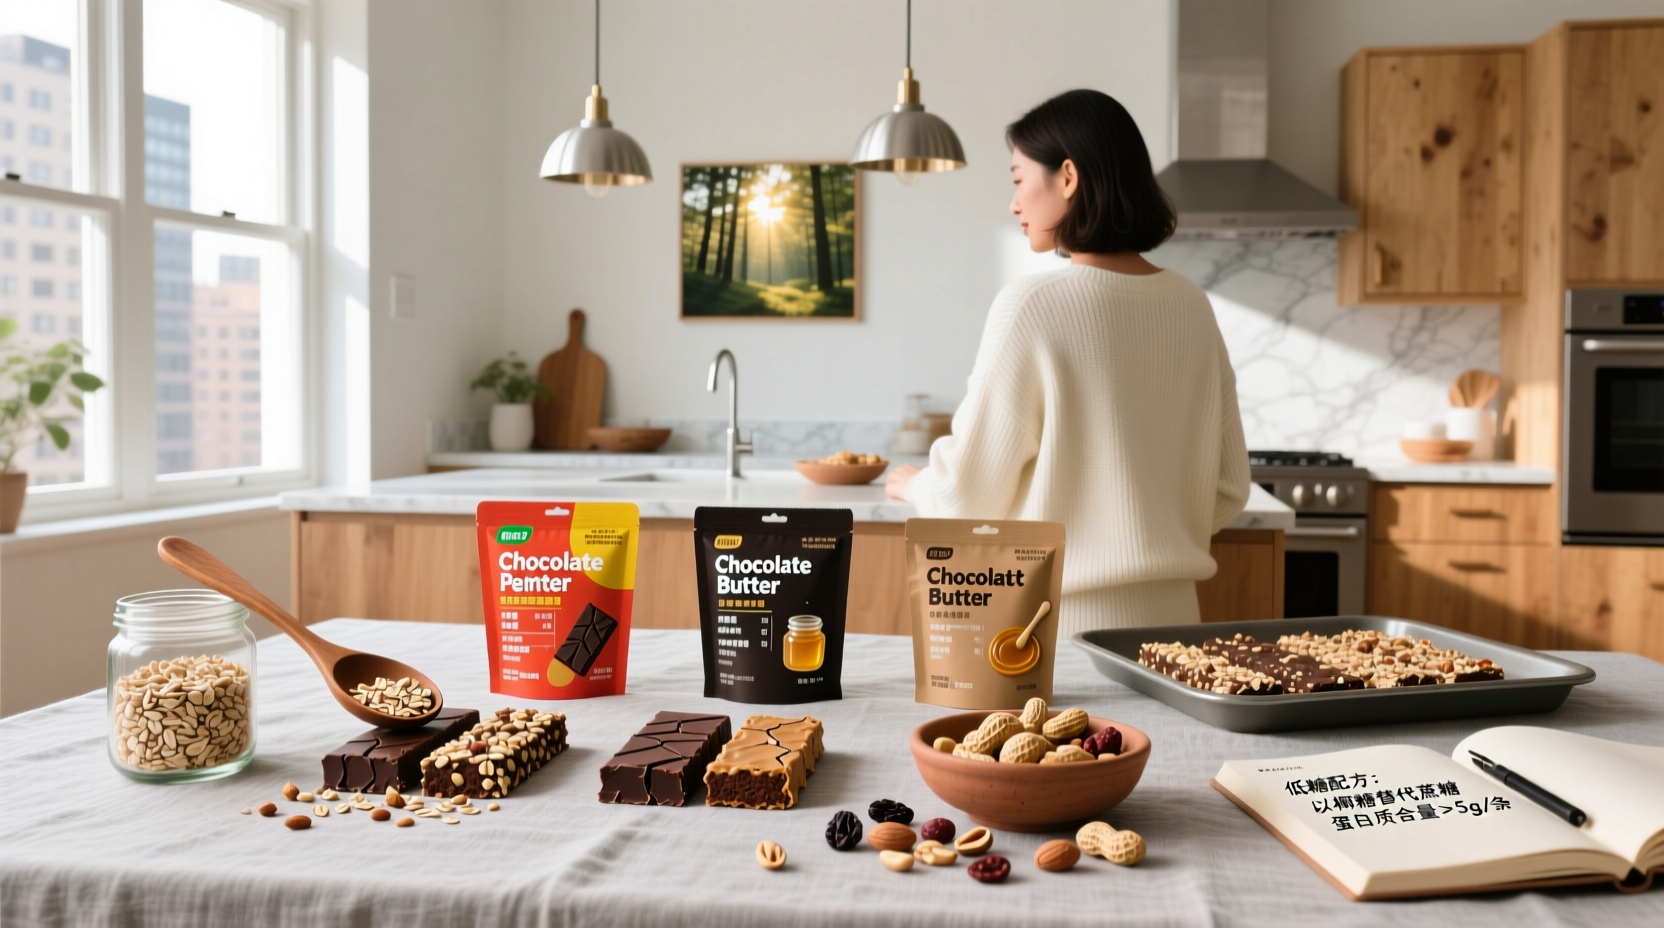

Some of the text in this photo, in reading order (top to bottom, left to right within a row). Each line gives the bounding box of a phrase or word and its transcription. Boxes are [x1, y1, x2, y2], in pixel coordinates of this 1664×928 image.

[498, 551, 604, 571] Chocolate
[715, 555, 812, 574] Chocolate
[717, 576, 781, 595] Butter
[927, 566, 1025, 587] Chocolatt
[928, 588, 993, 607] Butter
